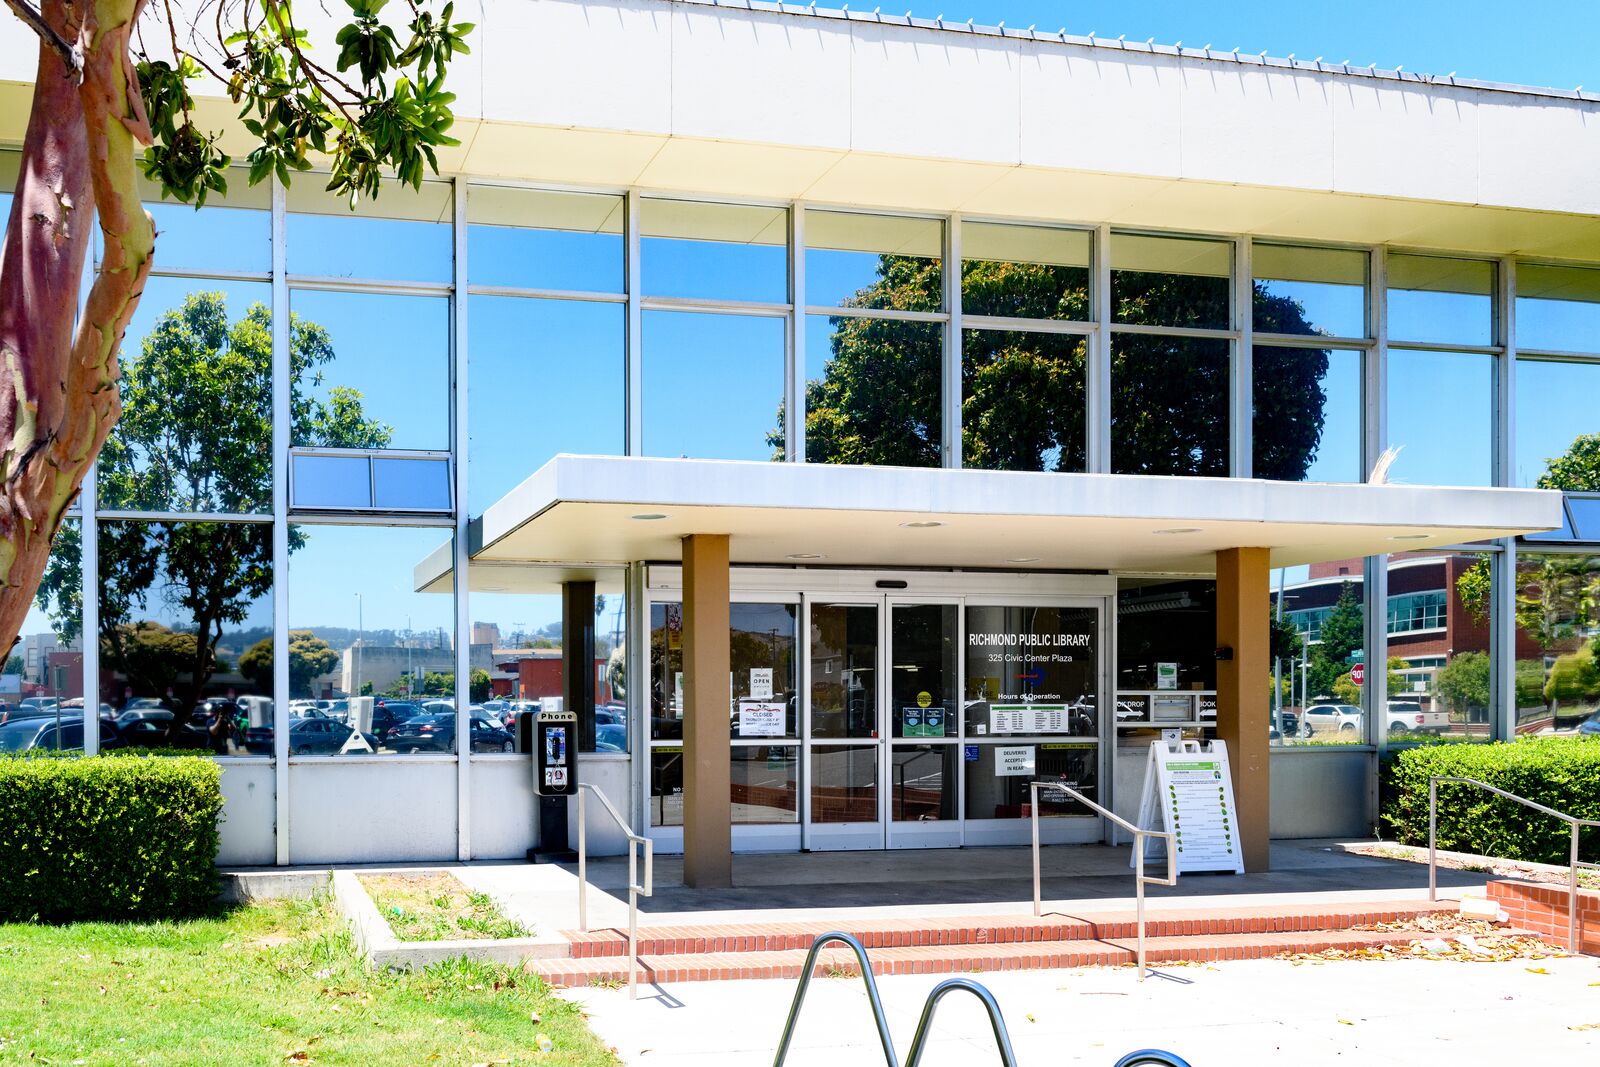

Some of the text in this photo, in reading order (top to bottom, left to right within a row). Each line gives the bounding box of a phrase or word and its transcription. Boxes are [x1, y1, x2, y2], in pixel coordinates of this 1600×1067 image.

[969, 633, 1090, 646] RICHMOND PUBLIC LIBRARY
[988, 653, 1073, 662] 325 Civic Center Plaza
[997, 692, 1018, 700] Hours
[1028, 692, 1061, 701] Operation
